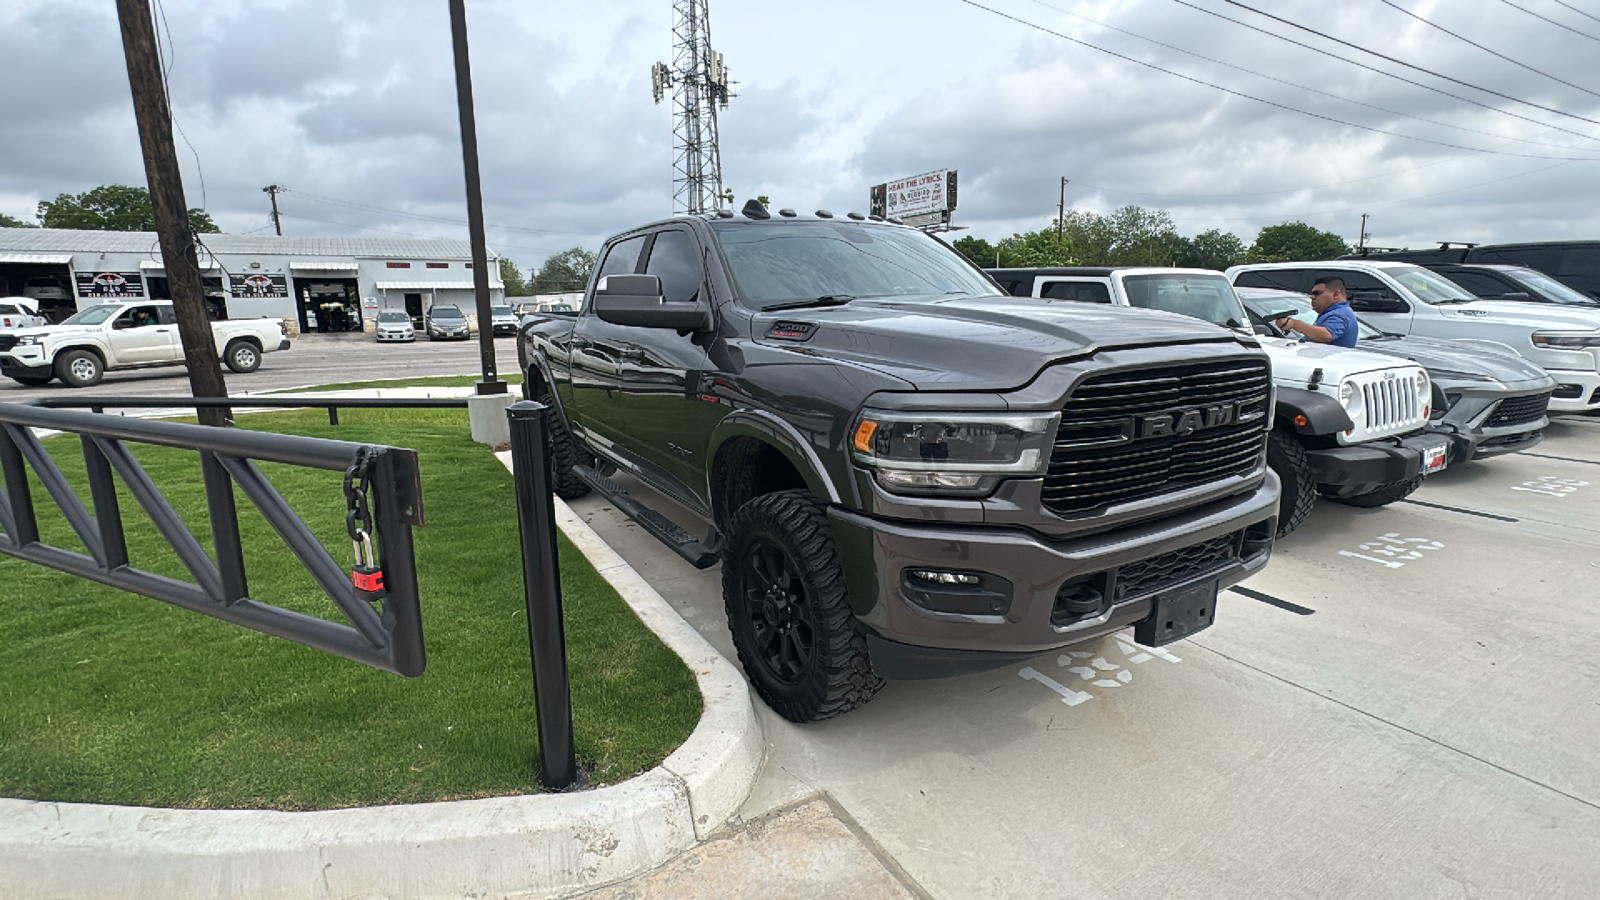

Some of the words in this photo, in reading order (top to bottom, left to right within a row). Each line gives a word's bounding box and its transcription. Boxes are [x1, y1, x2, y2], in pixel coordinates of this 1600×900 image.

[888, 182, 905, 192] HEAR
[906, 178, 917, 188] THE
[1141, 404, 1234, 437] RAM
[1338, 532, 1445, 569] 185
[1018, 633, 1183, 707] 184
